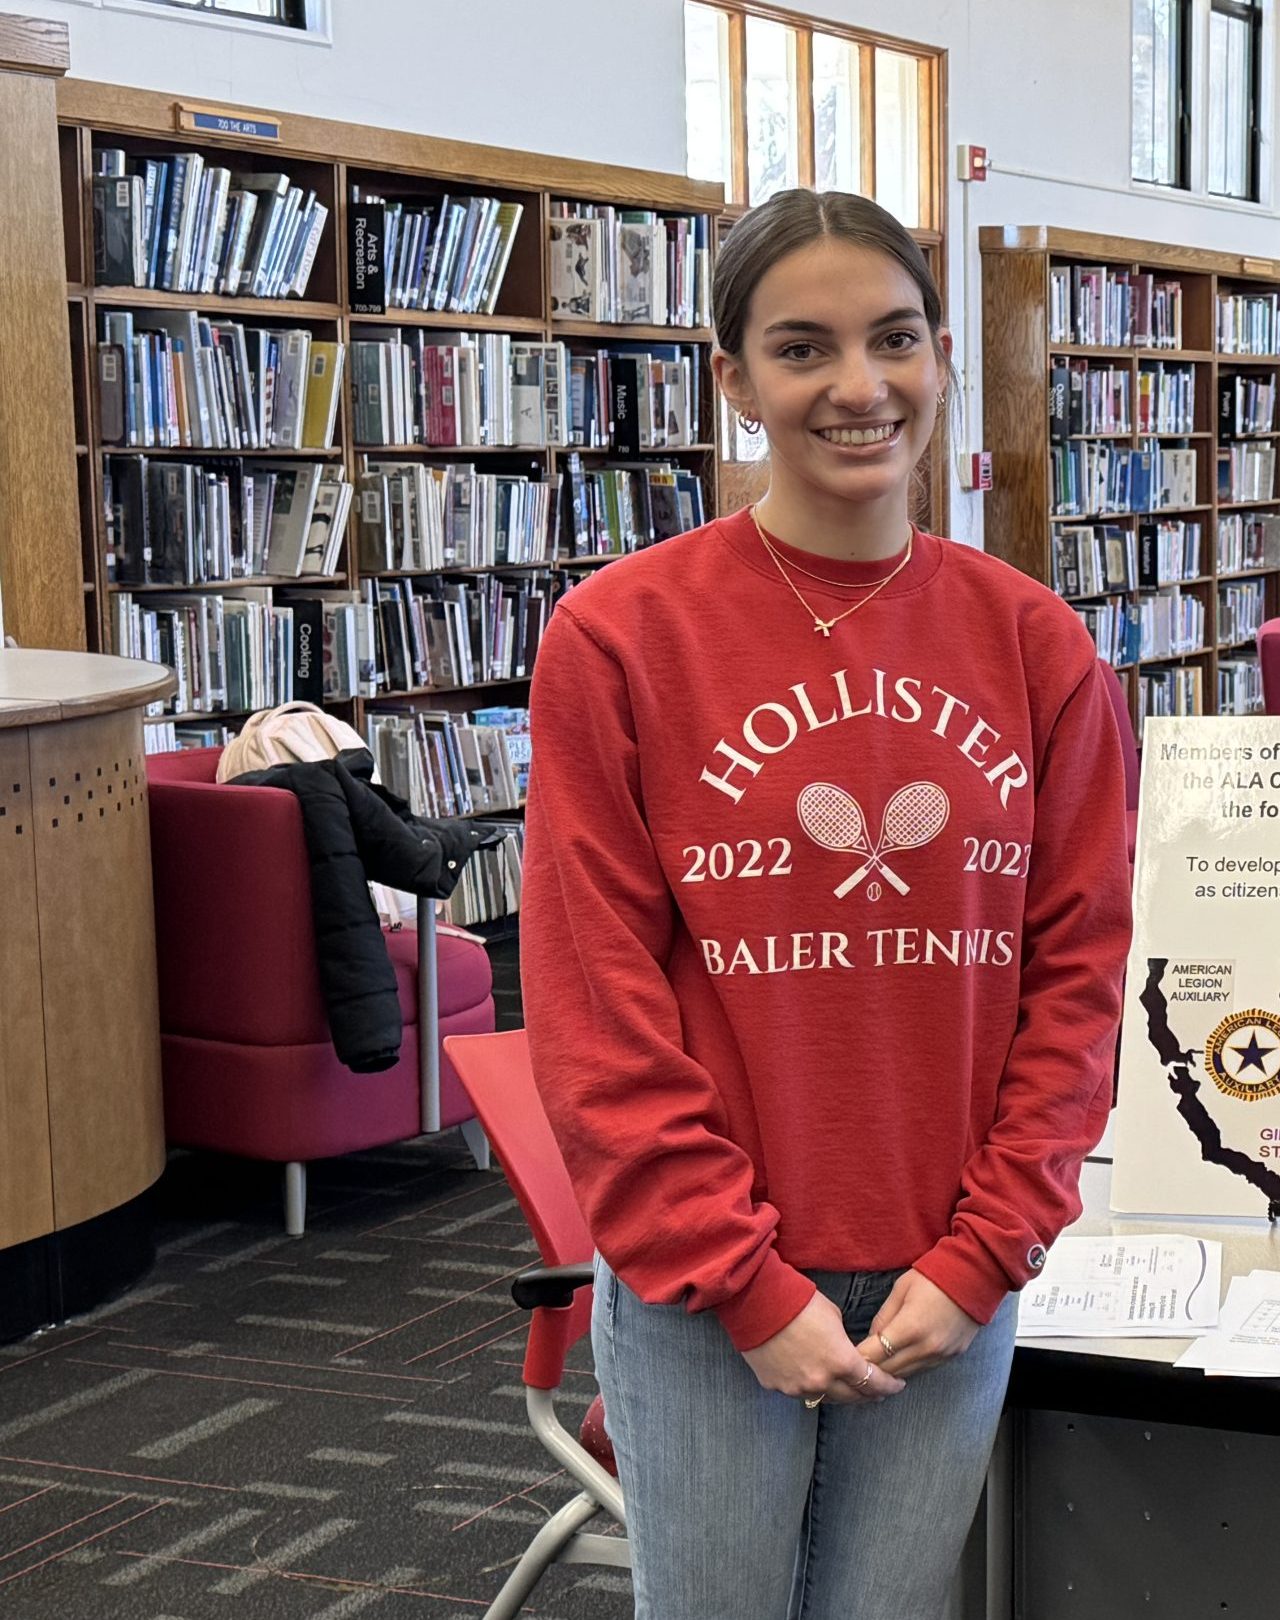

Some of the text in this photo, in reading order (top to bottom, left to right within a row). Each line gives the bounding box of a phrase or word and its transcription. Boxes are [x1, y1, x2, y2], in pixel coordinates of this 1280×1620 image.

[230, 121, 241, 132] THE
[242, 123, 257, 134] ARTS
[355, 217, 367, 290] Recreation
[367, 233, 379, 275] Arts &
[617, 384, 628, 420] Music
[297, 623, 313, 679] Cooking
[699, 668, 1029, 809] HOLLISTER
[1160, 743, 1253, 761] Members
[1260, 743, 1280, 760] of
[1183, 771, 1214, 789] the
[1221, 771, 1264, 789] ALA
[1221, 801, 1253, 818] the
[680, 836, 793, 884] 2022
[1186, 856, 1209, 872] To
[1194, 885, 1216, 898] as
[700, 927, 1015, 976] BALER TENNIS
[1171, 964, 1232, 975] AMERICAN
[1178, 978, 1223, 988] LEGION
[1170, 991, 1231, 1002] AUXILIARY
[1214, 1017, 1262, 1055] AMERICAN
